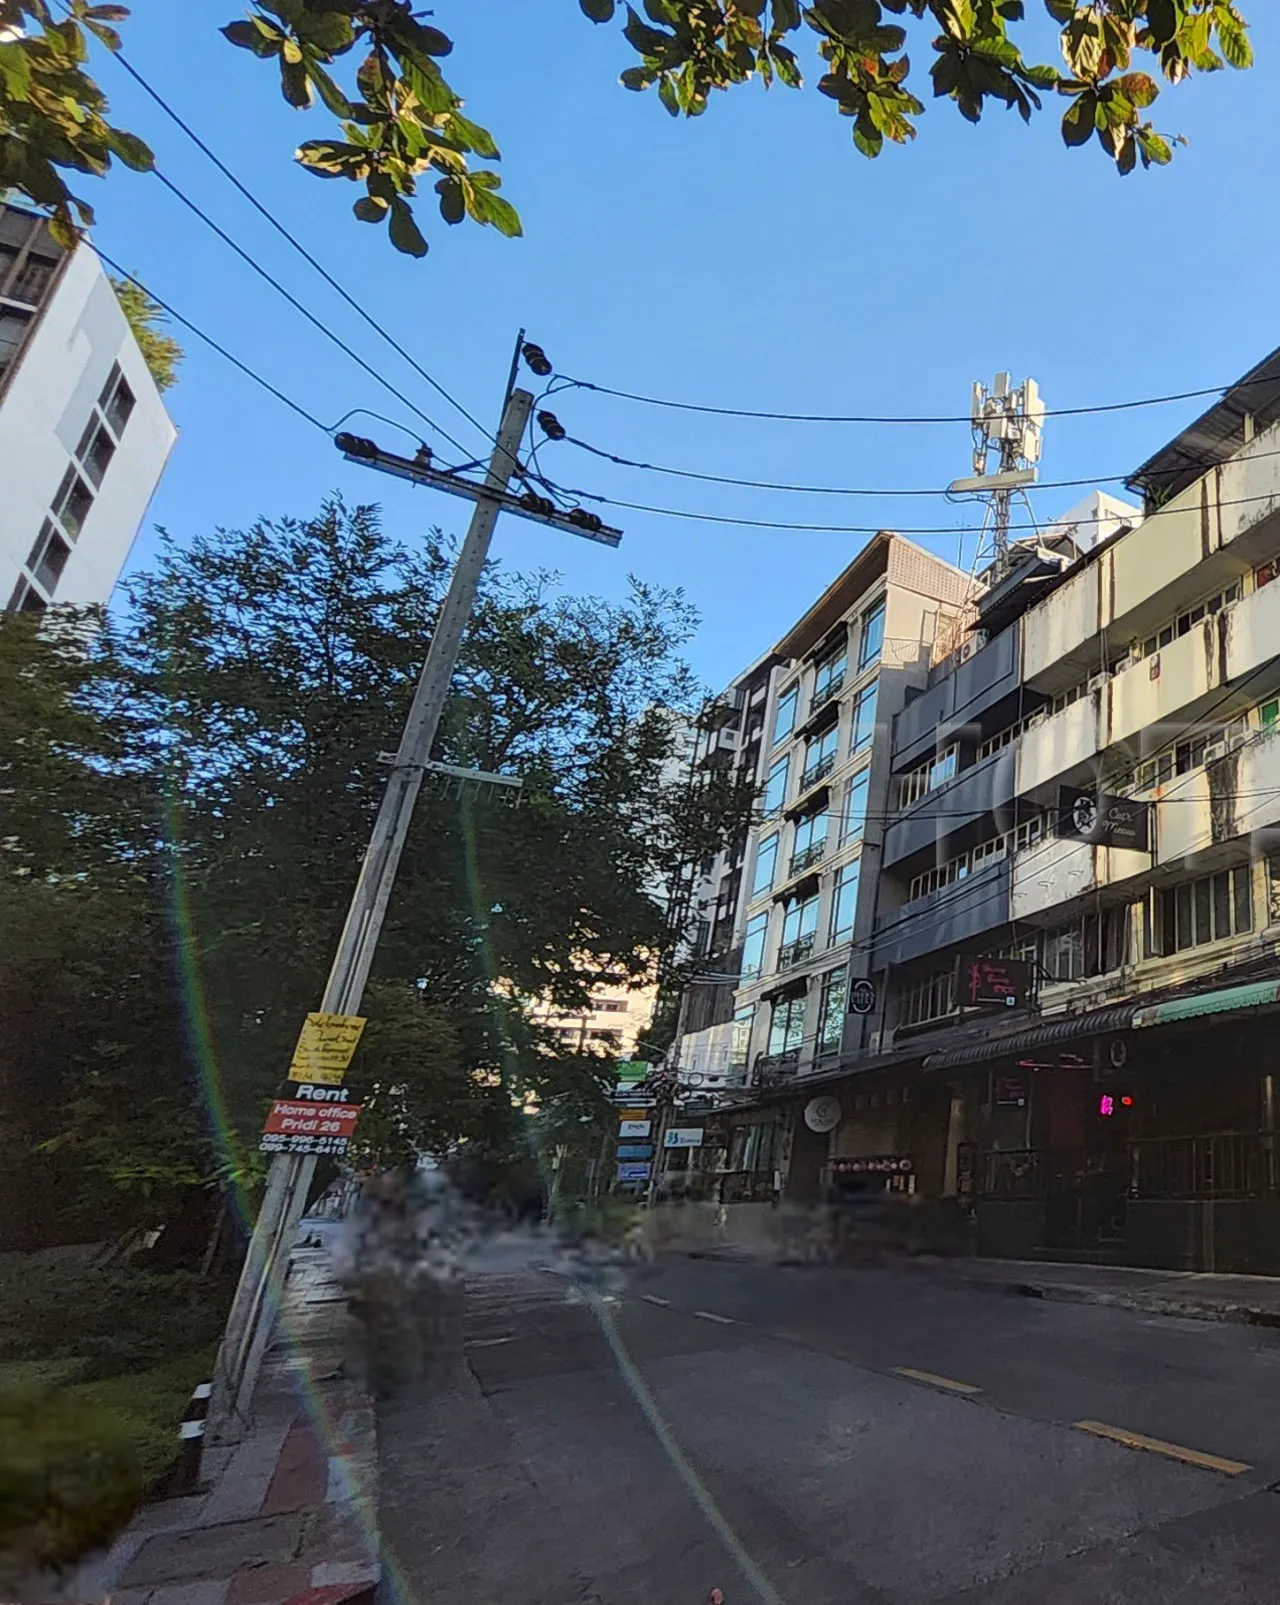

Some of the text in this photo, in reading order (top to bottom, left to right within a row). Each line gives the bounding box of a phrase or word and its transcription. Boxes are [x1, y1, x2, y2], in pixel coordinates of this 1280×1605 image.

[295, 1084, 349, 1102] Rent
[273, 1103, 358, 1119] Home office
[319, 1121, 341, 1132] 26
